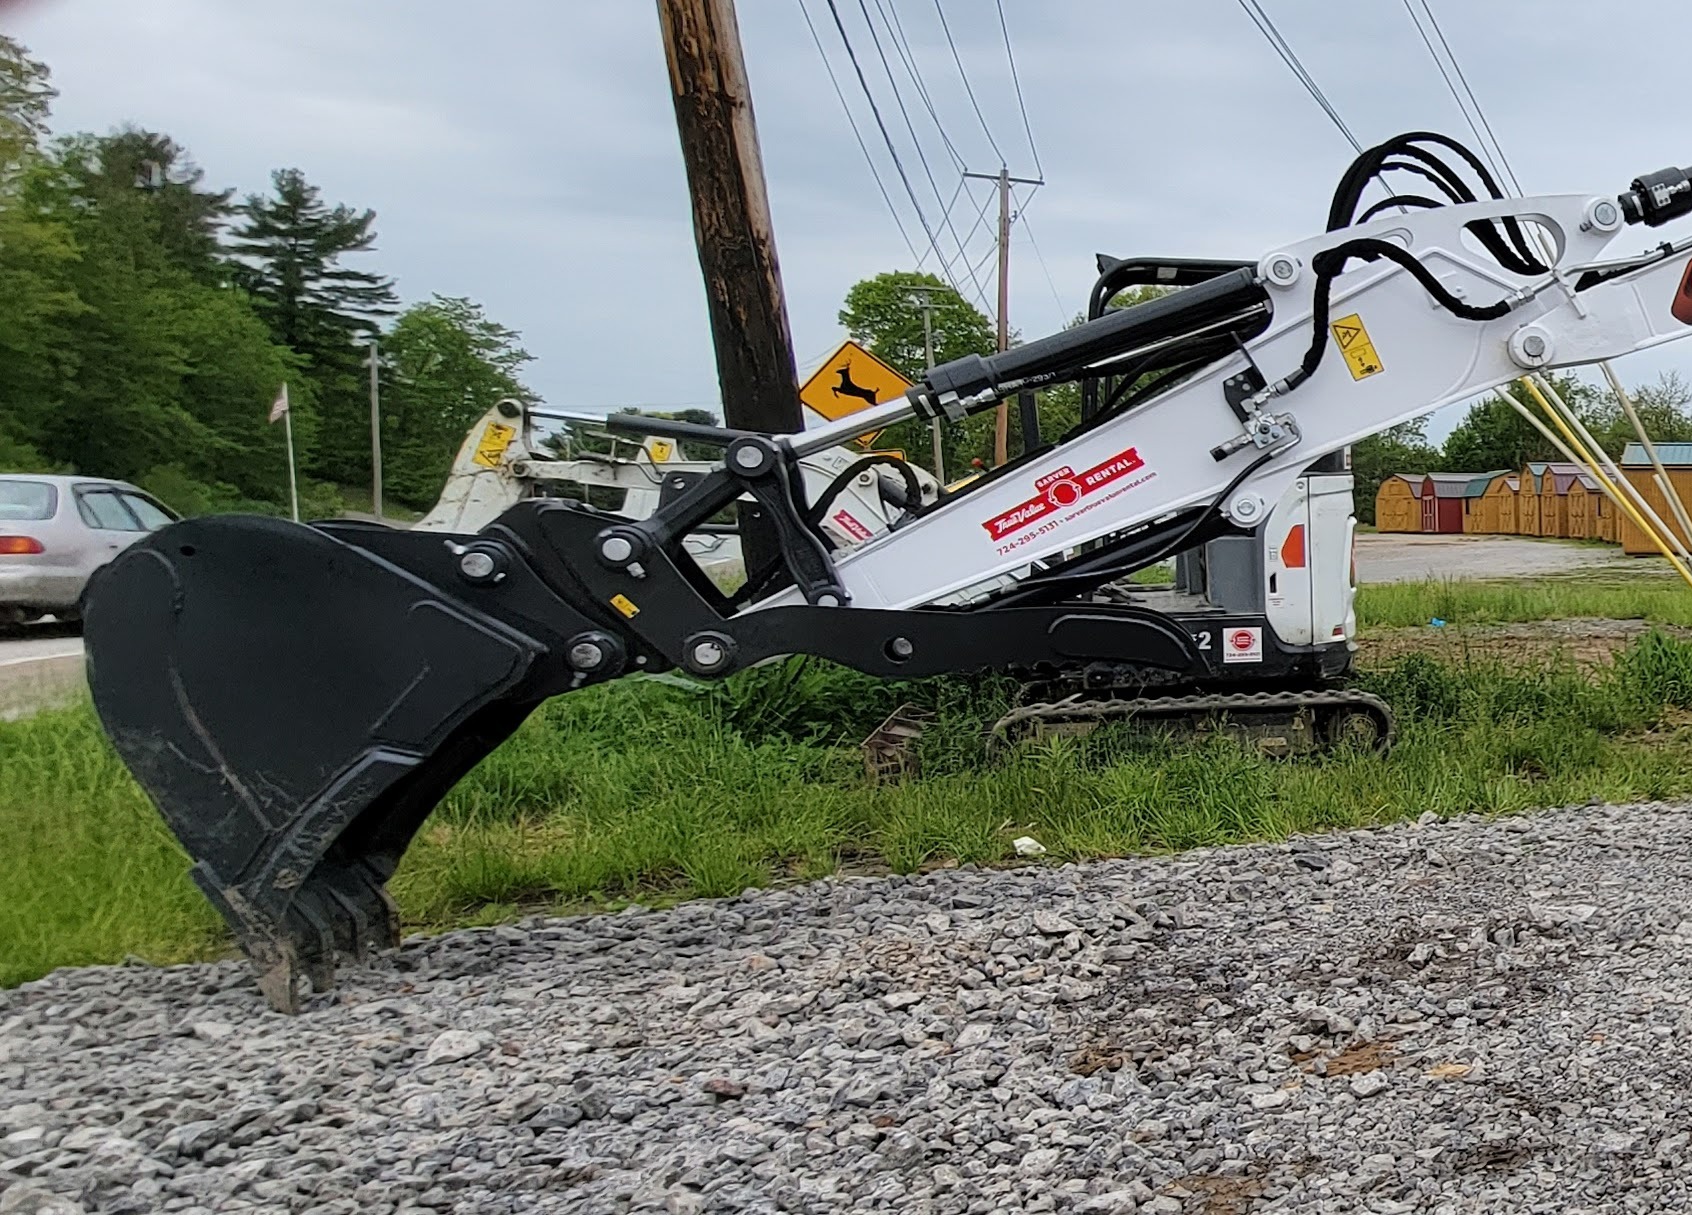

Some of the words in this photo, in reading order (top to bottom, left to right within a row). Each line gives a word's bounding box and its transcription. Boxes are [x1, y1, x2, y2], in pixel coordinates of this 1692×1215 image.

[1037, 467, 1071, 488] SARVER
[1085, 458, 1134, 486] RENTAL
[996, 520, 1060, 557] 724-295-5131
